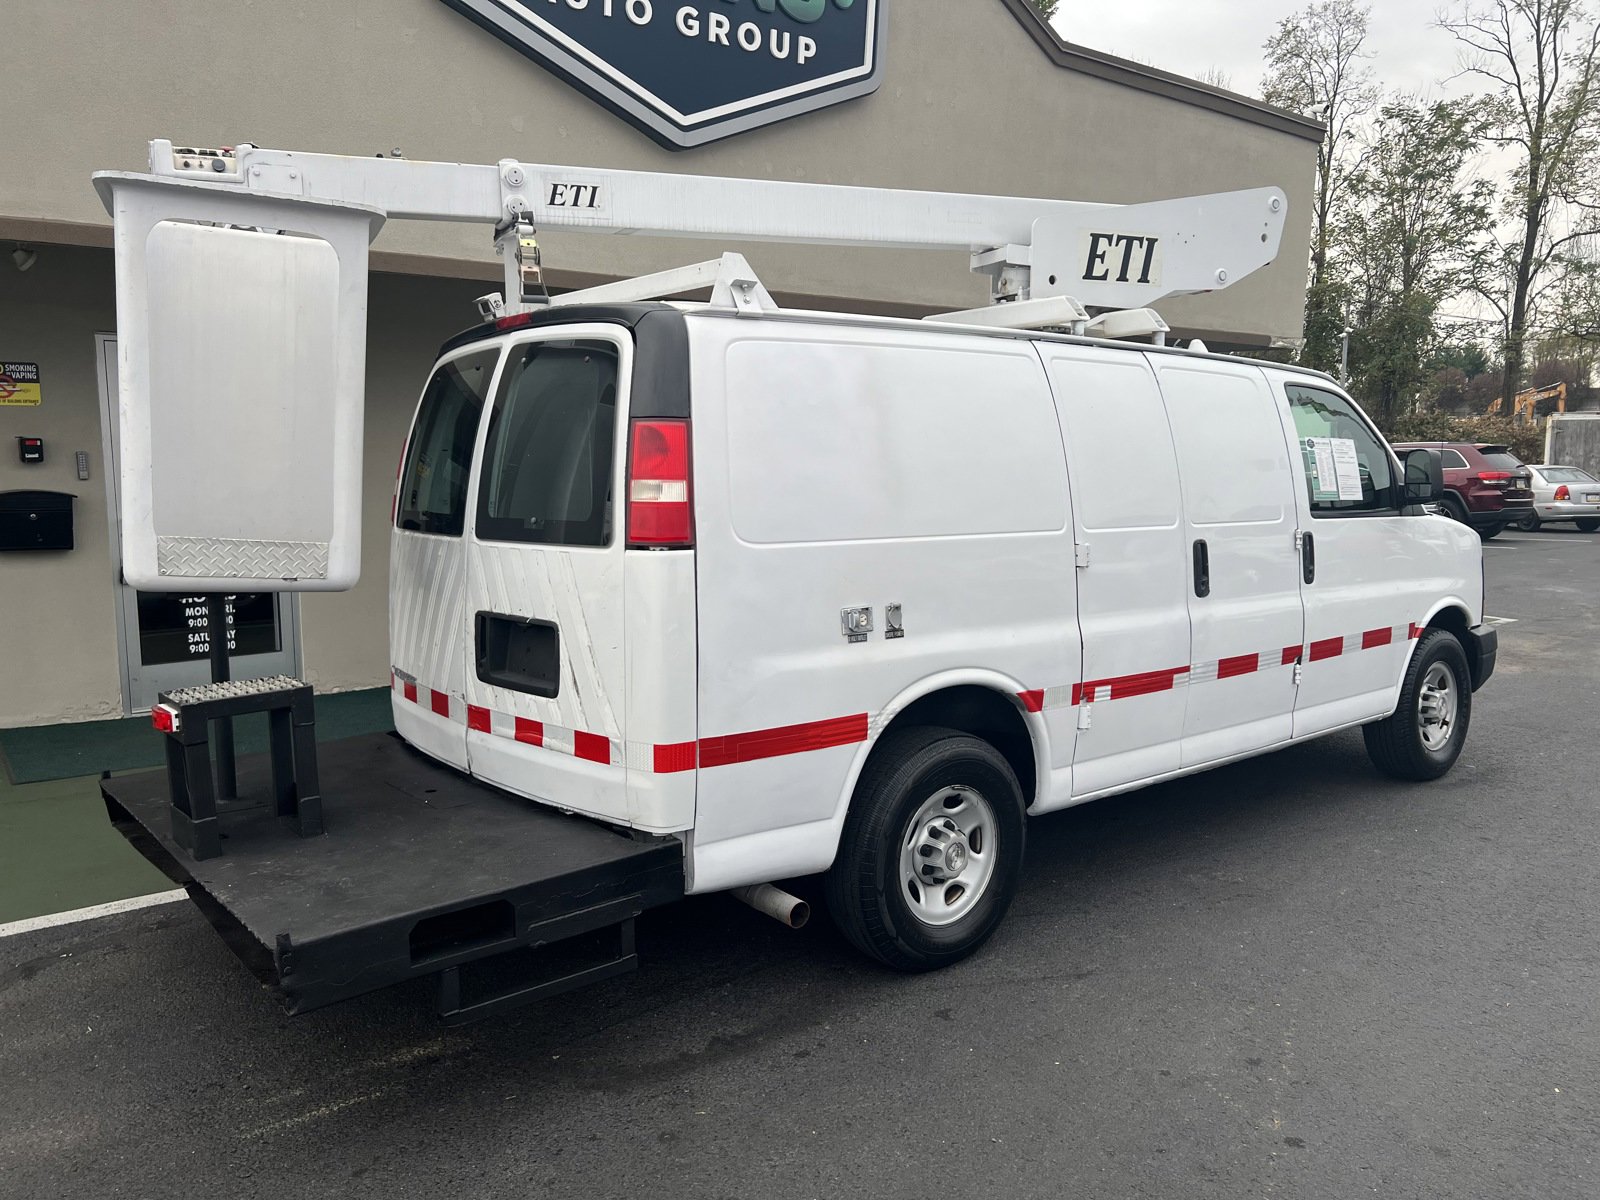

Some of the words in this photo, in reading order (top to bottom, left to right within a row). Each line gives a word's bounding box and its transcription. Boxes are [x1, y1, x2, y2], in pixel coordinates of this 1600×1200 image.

[675, 5, 817, 65] GROUP
[547, 183, 600, 208] ETI
[1082, 232, 1158, 283] ETI
[4, 364, 37, 372] SMOKING
[188, 617, 208, 628] 9:00
[189, 643, 210, 654] 9:00
